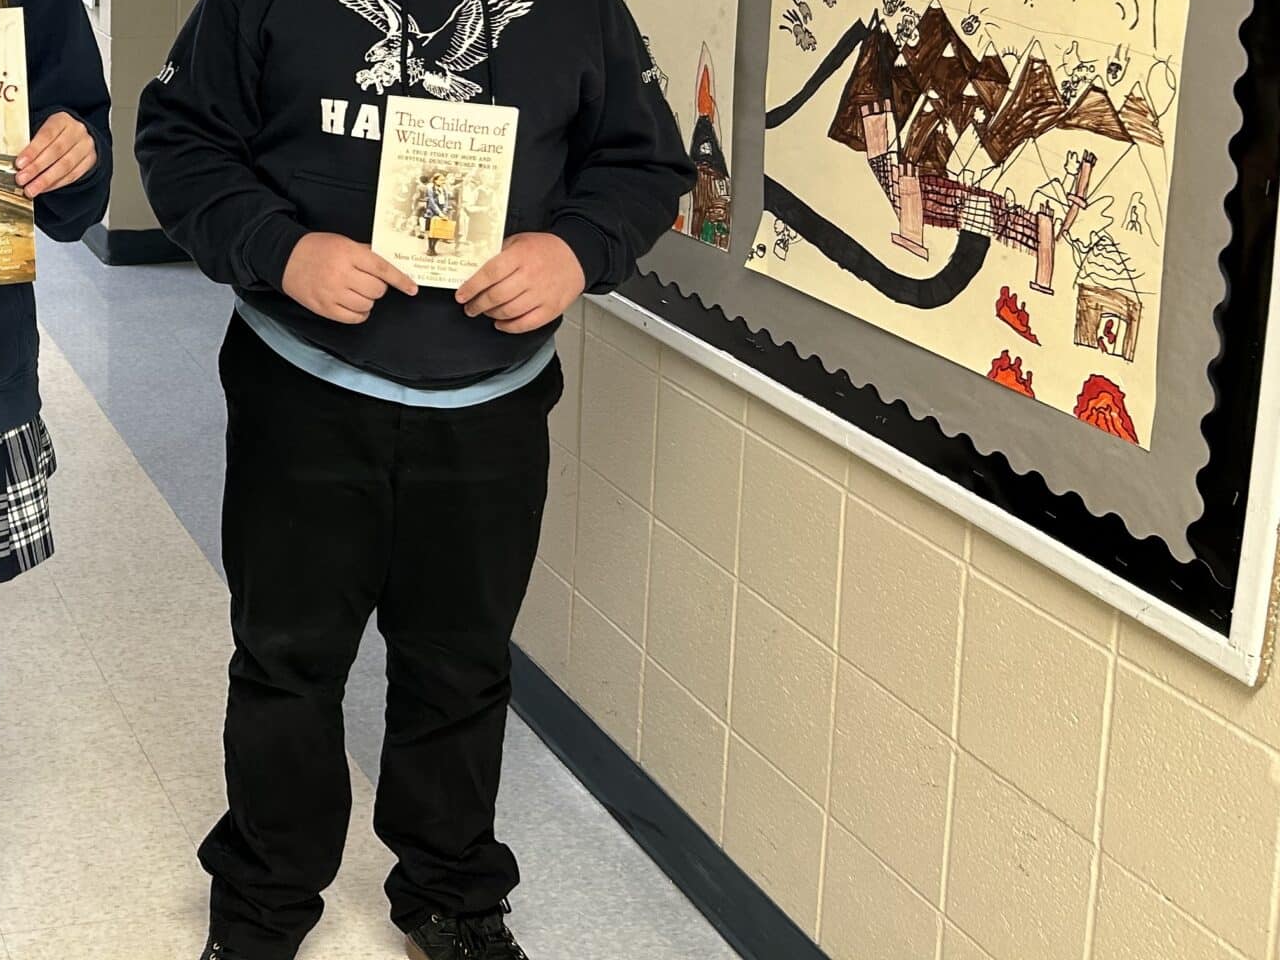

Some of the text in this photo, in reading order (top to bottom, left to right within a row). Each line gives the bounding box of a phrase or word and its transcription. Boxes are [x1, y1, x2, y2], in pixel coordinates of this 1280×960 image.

[395, 111, 510, 137] The Children of
[395, 129, 504, 154] Willesden Lane
